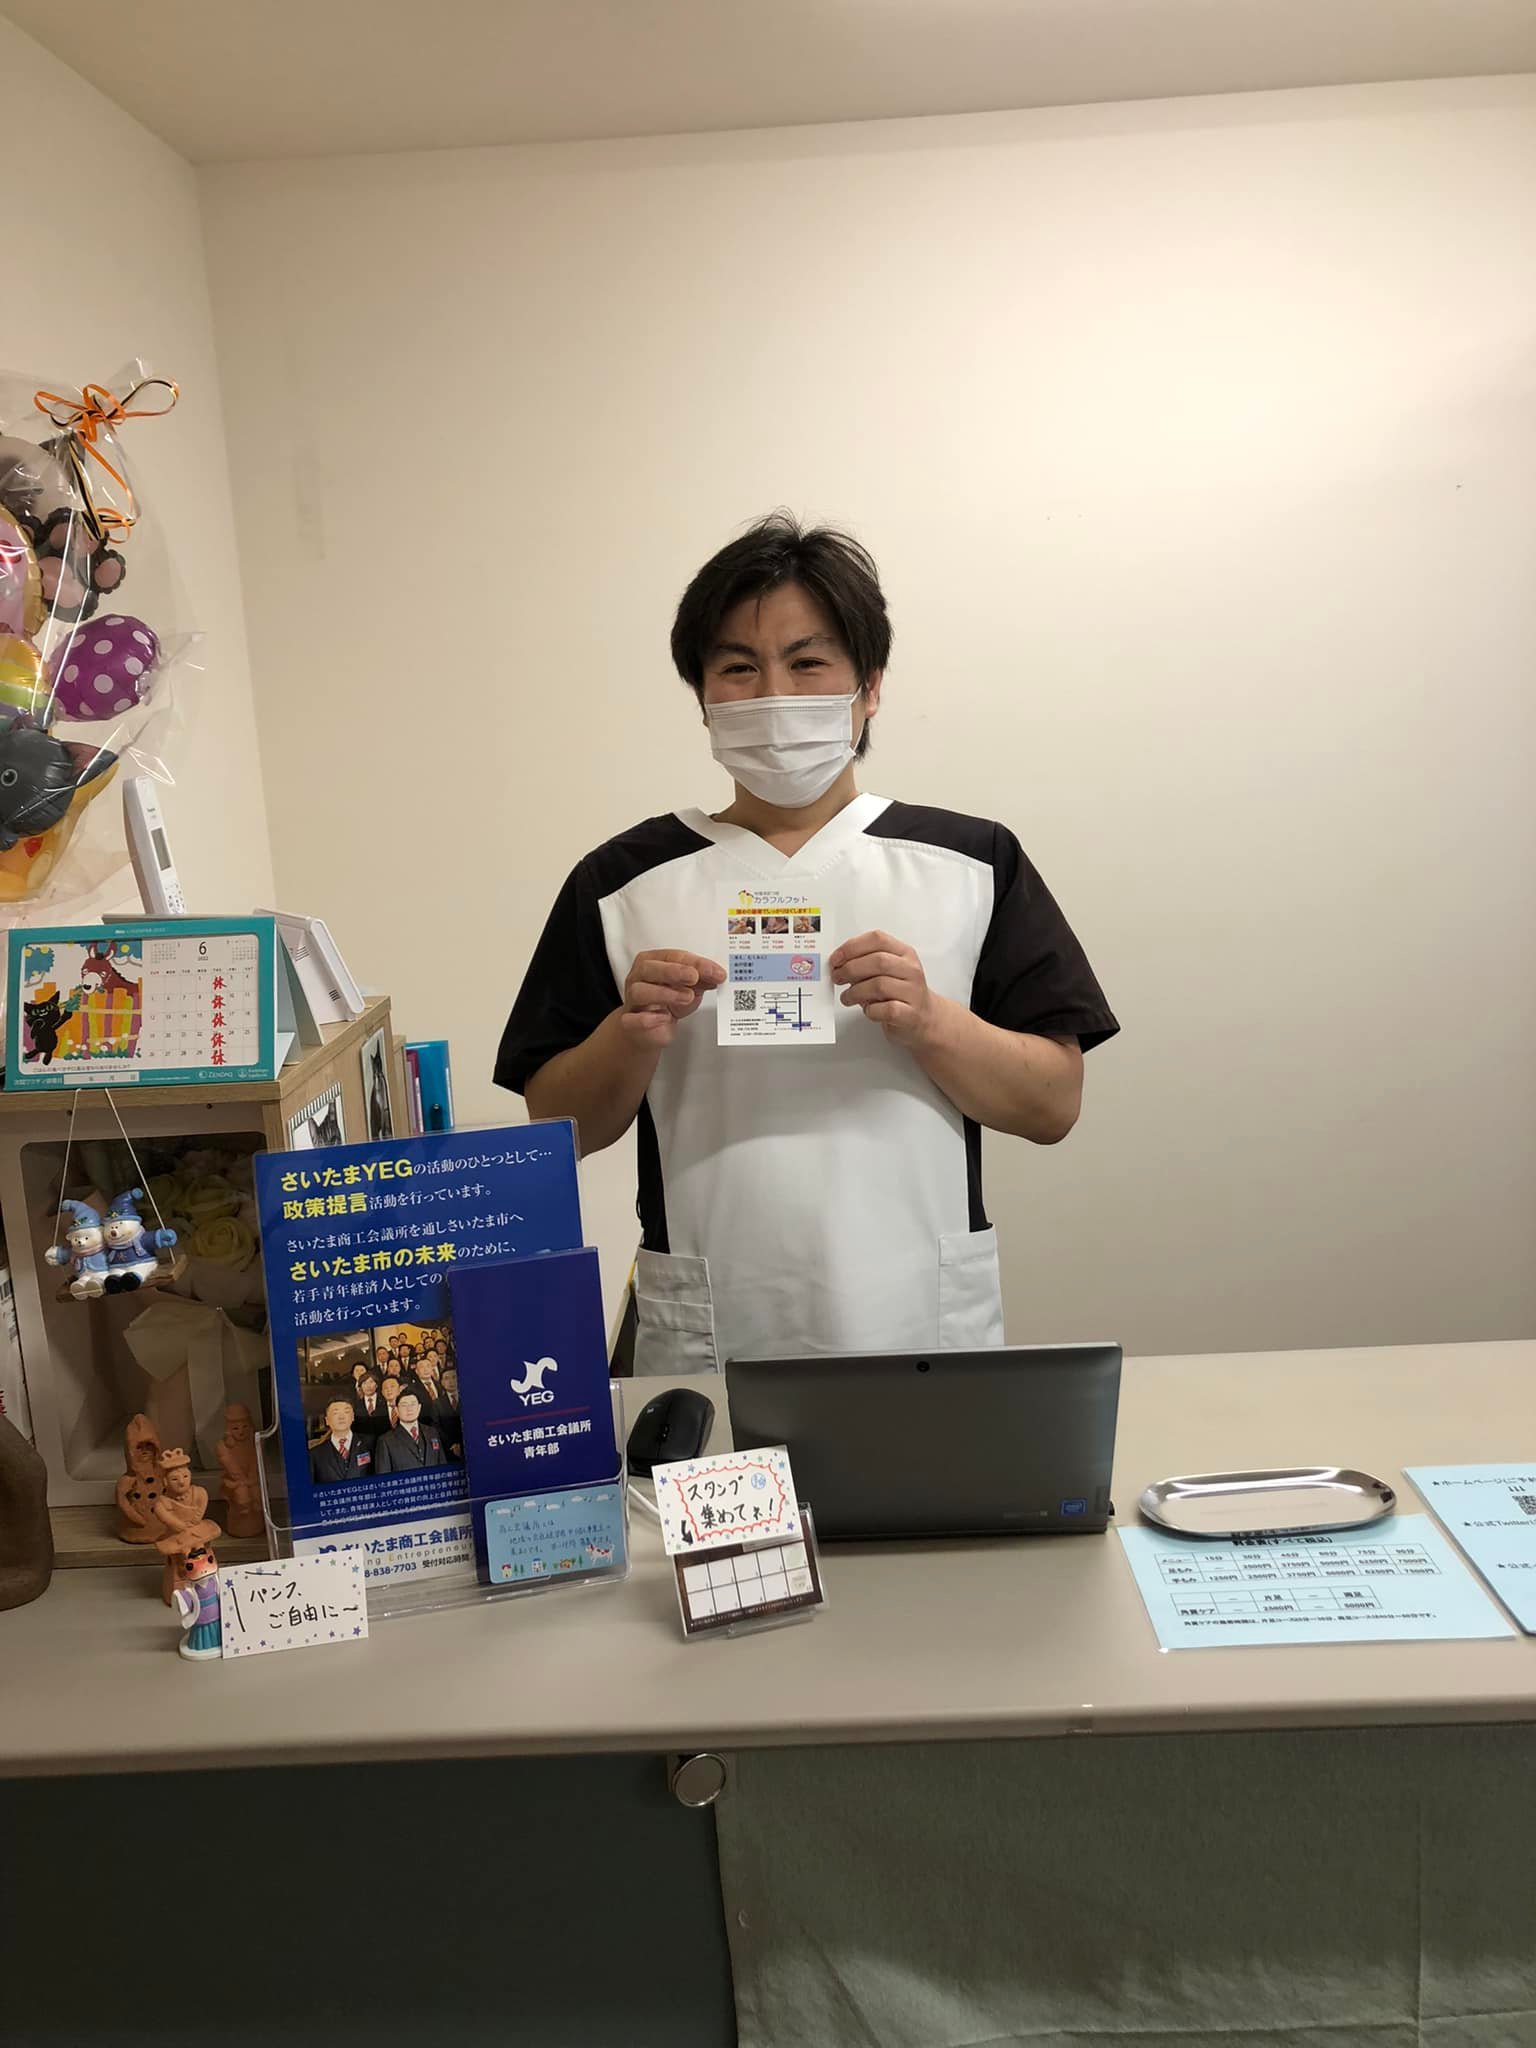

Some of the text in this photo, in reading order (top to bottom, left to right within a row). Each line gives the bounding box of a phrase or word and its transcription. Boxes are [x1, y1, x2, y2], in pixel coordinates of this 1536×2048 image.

[198, 941, 207, 956] 6
[212, 976, 227, 990] 休
[211, 995, 226, 1009] 休
[211, 1012, 227, 1028] 休
[210, 1032, 226, 1048] 休
[211, 1049, 227, 1065] 休
[280, 1150, 553, 1192] さいたまYEGの活動のひとつとして…
[282, 1183, 492, 1221] 政策提言活動を行っています。
[286, 1213, 525, 1253] さいたま商工会議所を通しさいたま市へ
[289, 1241, 517, 1281] さいたま市の未来のために、
[292, 1272, 443, 1304] 若手青年経済人としての
[294, 1298, 421, 1327] 活動を行っています。
[519, 1390, 554, 1407] YEG
[487, 1419, 592, 1447] さいたま商工会議所
[523, 1442, 560, 1459] 青年部
[687, 1475, 744, 1501] スタンプ
